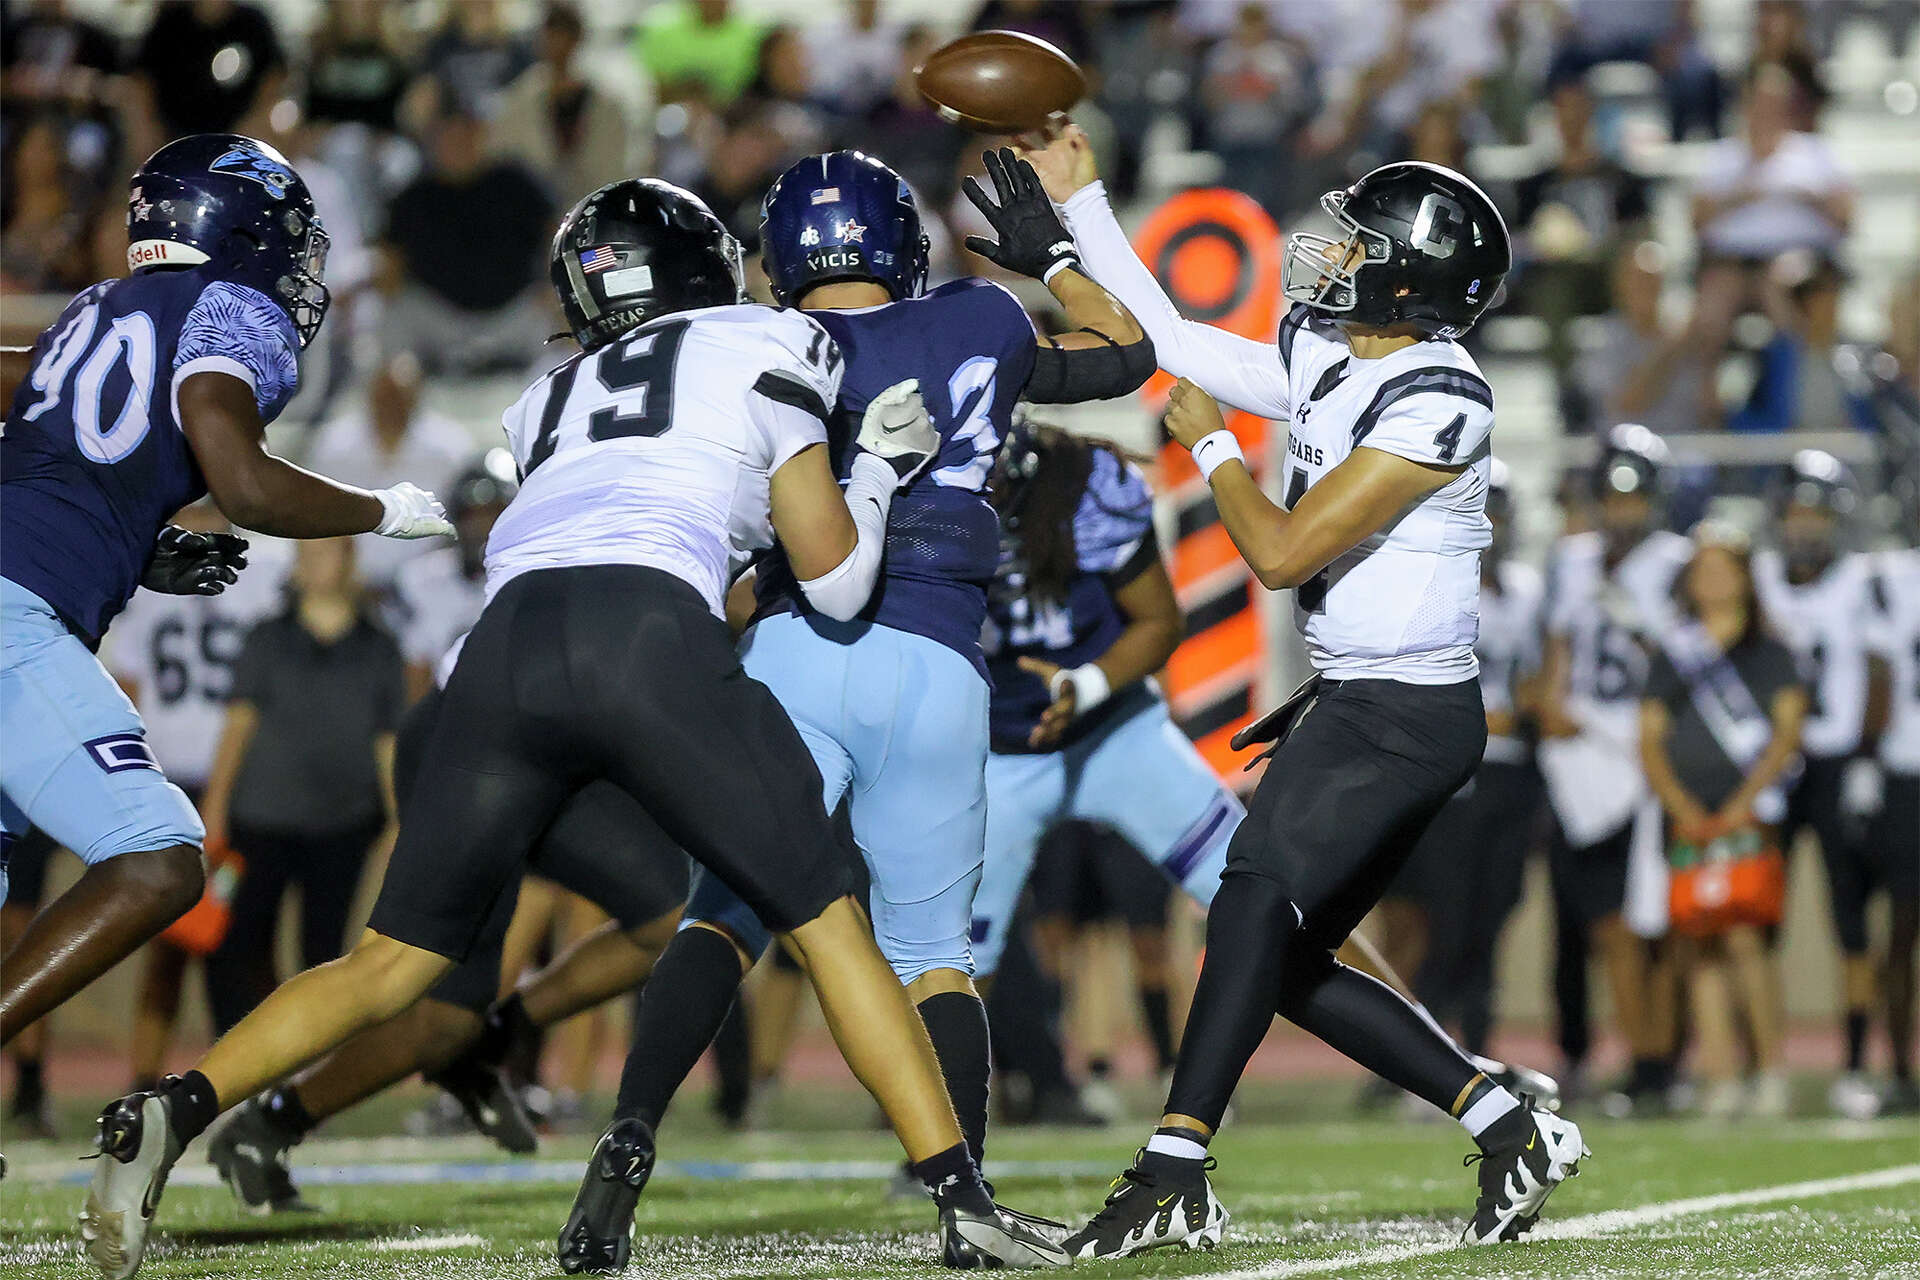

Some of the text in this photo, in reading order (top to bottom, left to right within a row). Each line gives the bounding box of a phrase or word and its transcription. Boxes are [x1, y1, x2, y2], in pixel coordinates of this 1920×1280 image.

[1410, 193, 1466, 258] C
[807, 252, 860, 271] VICIS
[23, 303, 157, 465] 90
[1433, 412, 1467, 463] 4
[151, 614, 238, 706] 65
